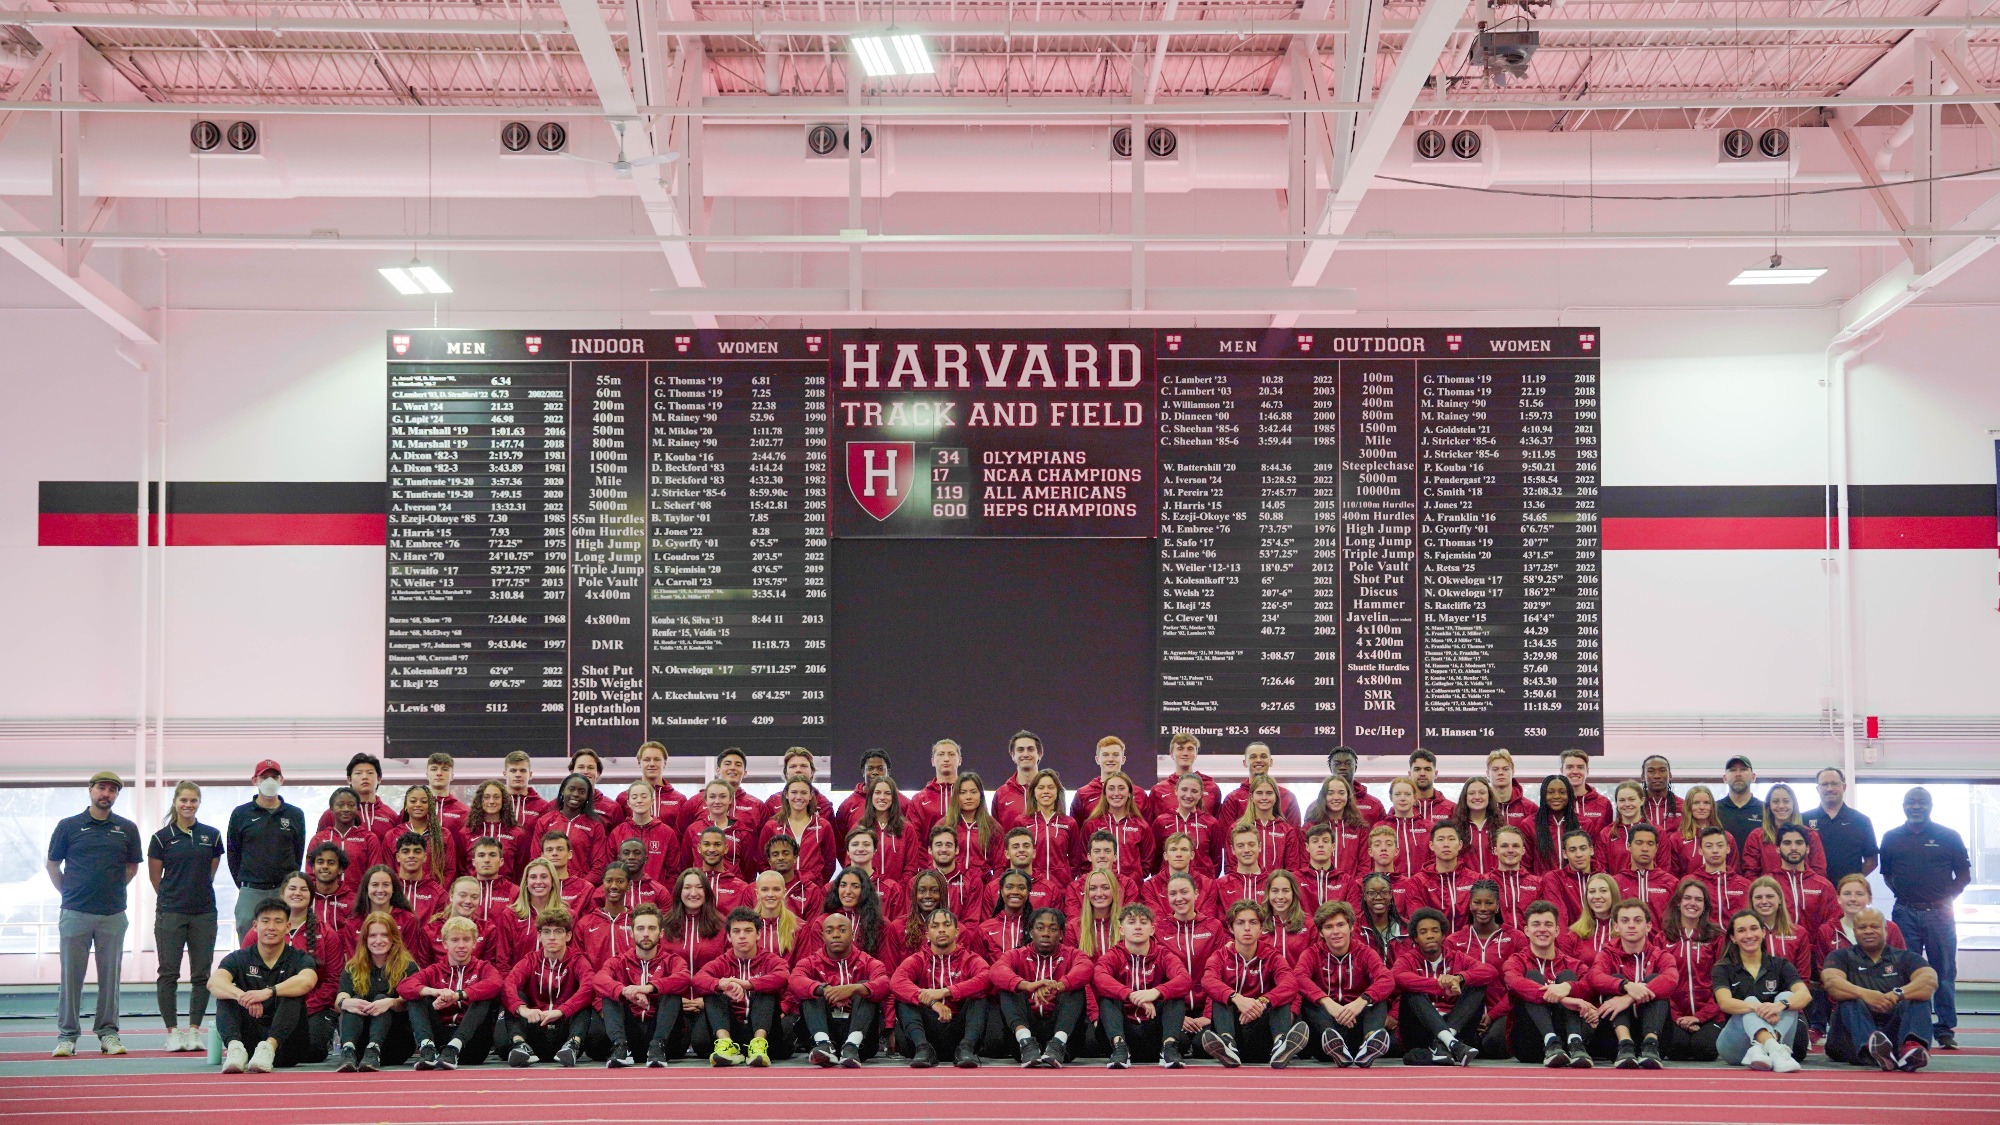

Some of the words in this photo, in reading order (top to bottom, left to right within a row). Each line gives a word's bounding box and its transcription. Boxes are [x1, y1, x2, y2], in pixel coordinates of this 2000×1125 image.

[447, 342, 486, 355] MEN
[571, 338, 645, 354] INDOOR
[717, 342, 778, 354] WOMEN
[1219, 340, 1257, 352] MEN
[1333, 337, 1425, 352] OUTDOOR
[1489, 340, 1551, 352] WOMEN
[842, 343, 1141, 388] HARVARD
[596, 375, 621, 386] 55m
[1163, 375, 1173, 384] C.
[1175, 375, 1213, 384] Lambert
[1261, 375, 1284, 384] 10.28
[1313, 375, 1333, 384] 2022
[1363, 372, 1394, 383] 100m
[1423, 374, 1435, 384] G.
[1436, 375, 1475, 384] Thomas
[1522, 374, 1547, 384] 11.19
[1574, 374, 1596, 384] 2018
[596, 387, 621, 398] 60m
[1362, 384, 1394, 395] 200m
[593, 400, 624, 411] 200m
[1361, 397, 1394, 408] 400m
[592, 412, 625, 423] 400m
[840, 402, 956, 427] TRACK
[968, 402, 1037, 427] AND
[1050, 402, 1142, 426] FIELD
[1362, 410, 1394, 420] 800m
[592, 425, 624, 436] 500m
[1160, 424, 1172, 433] C.
[1173, 424, 1213, 433] Sheehan
[1258, 424, 1292, 433] 3:42.44
[1314, 424, 1336, 433] 1985
[1360, 422, 1397, 433] 1500m
[392, 439, 407, 449] M.
[407, 439, 451, 449] Marshall
[490, 439, 525, 449] 1:47.74
[543, 439, 565, 449] 2018
[592, 438, 624, 448] 800m
[1365, 435, 1392, 445] Mile
[590, 450, 628, 461] 1000m
[938, 450, 960, 464] 34
[983, 451, 1086, 465] OLYMPIANS
[1358, 448, 1397, 459] 3000m
[590, 463, 628, 474] 1500m
[651, 463, 663, 472] D.
[665, 463, 708, 472] Beckford
[749, 463, 783, 472] 4:14.24
[805, 463, 826, 472] 1982
[1342, 460, 1415, 473] Steeplechase
[863, 449, 898, 497] H
[933, 468, 949, 482] 17
[983, 468, 1033, 482] NCAA
[1038, 468, 1142, 482] CHAMPIONS
[1359, 473, 1397, 483] 5000m
[595, 475, 622, 486] Mile
[588, 488, 628, 499] 3000m
[936, 486, 963, 499] 119
[983, 486, 1017, 499] ALL
[1022, 486, 1126, 499] AMERICANS
[1356, 485, 1401, 496] 10000m
[1423, 487, 1435, 497] C.
[1436, 487, 1466, 497] Smith
[1522, 486, 1563, 496] 32:08.32
[1576, 486, 1598, 496] 2016
[589, 500, 628, 511] 5000m
[933, 503, 967, 517] 600
[983, 503, 1028, 517] HEPS
[1033, 503, 1137, 517] CHAMPIONS
[389, 514, 399, 523] S.
[400, 514, 459, 525] Ezeji-Okoye
[488, 514, 508, 523] 7.30
[544, 513, 566, 523] 1985
[571, 514, 596, 524] 55m
[599, 514, 645, 524] Hurdles
[1341, 511, 1370, 521] 400m
[1373, 511, 1415, 521] Hurdles
[571, 526, 596, 537] 60m
[599, 526, 645, 536] Hurdles
[1346, 523, 1374, 536] High
[1377, 523, 1411, 536] Jump
[575, 538, 604, 552] High
[607, 538, 641, 552] Jump
[1345, 536, 1376, 549] Long
[1378, 536, 1412, 549] Jump
[575, 551, 605, 564] Long
[608, 551, 642, 564] Jump
[1342, 548, 1378, 561] Triple
[1381, 548, 1415, 561] Jump
[571, 564, 608, 577] Triple
[610, 564, 645, 577] Jump
[1349, 561, 1374, 572] Pole
[1377, 561, 1409, 571] Vault
[578, 576, 603, 587] Pole
[606, 576, 638, 587] Vault
[1353, 573, 1380, 584] Shot
[1384, 573, 1404, 584] Put
[584, 589, 631, 600] 4x400m
[1360, 586, 1398, 597] Discus
[1353, 599, 1405, 609] Hammer
[584, 614, 631, 625] 4x800m
[1346, 611, 1389, 622] Javelin
[1356, 624, 1402, 635] 4x100m
[592, 639, 624, 650] DMR
[1375, 636, 1404, 647] 200m
[1356, 649, 1402, 660] 4x400m
[582, 665, 609, 676] Shot
[613, 665, 633, 675] Put
[571, 677, 598, 688] 35lb
[601, 677, 643, 691] Weight
[1356, 674, 1402, 685] 4x800m
[572, 690, 598, 701] 20lb
[601, 690, 643, 703] Weight
[1364, 689, 1393, 700] SMR
[386, 704, 398, 713] A.
[400, 703, 429, 713] Lewis
[485, 703, 508, 713] 5112
[541, 703, 564, 712] 2008
[574, 703, 641, 716] Heptathlon
[1364, 700, 1396, 711] DMR
[575, 715, 640, 726] Pentathlon
[651, 716, 665, 725] M.
[666, 716, 710, 725] Salander
[751, 715, 774, 725] 4209
[802, 715, 825, 725] 2013
[1160, 725, 1170, 735] P.
[1170, 725, 1224, 737] Rittenburg
[1258, 725, 1281, 735] 6654
[1314, 726, 1336, 735] 1982
[1355, 725, 1405, 739] Dec/Hep
[1425, 727, 1439, 737] M.
[1441, 727, 1477, 737] Hansen
[1524, 727, 1547, 737] 5530
[1578, 727, 1600, 737] 2016
